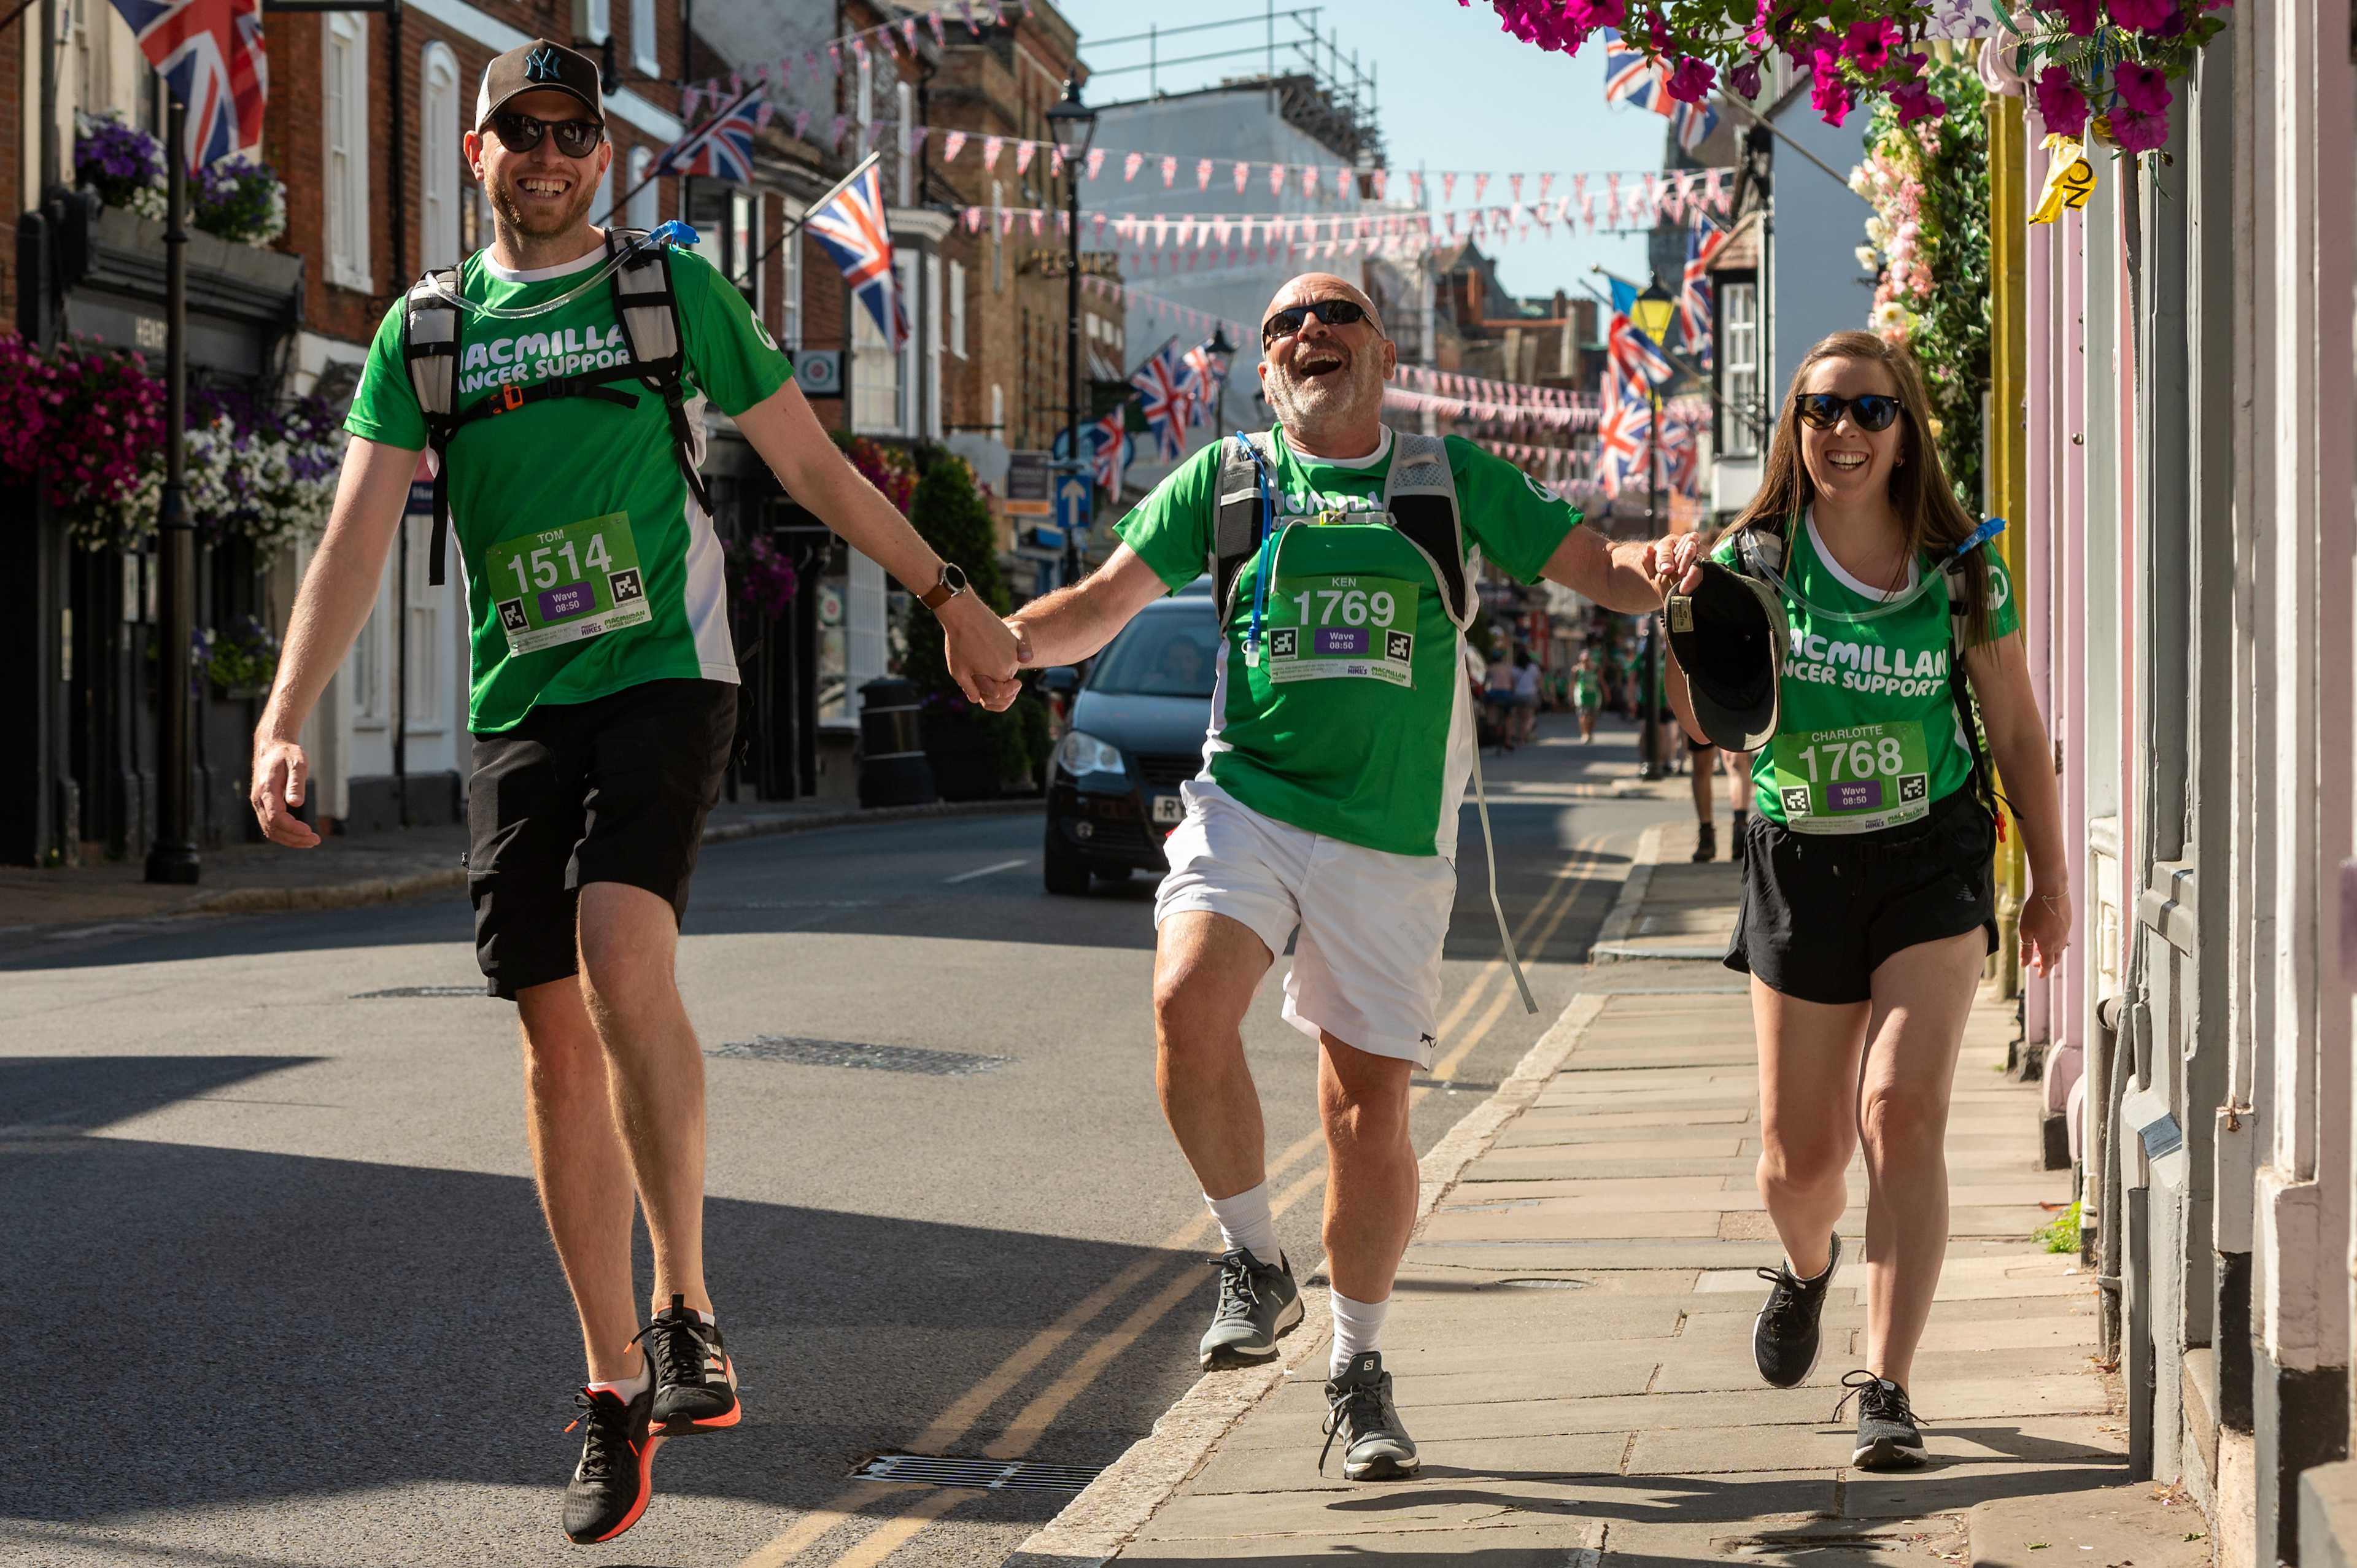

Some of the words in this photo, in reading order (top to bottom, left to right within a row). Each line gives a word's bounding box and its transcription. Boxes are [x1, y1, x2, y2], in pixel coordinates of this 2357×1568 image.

[525, 48, 561, 80] NY
[2063, 159, 2093, 209] NO
[460, 324, 627, 373] ACMILLA
[459, 363, 529, 393] NCER
[535, 349, 631, 379] SUPPOR
[537, 529, 564, 544] TOM
[508, 533, 613, 593] 1514
[1332, 577, 1357, 587] KEN
[552, 590, 578, 603] Wave
[555, 600, 580, 614] 08:50
[1293, 590, 1395, 627] 1769
[581, 625, 602, 636] HIKES
[1329, 632, 1355, 641] Wave
[1329, 641, 1354, 650] 08:50
[1790, 628, 1948, 678] ACMILLAN
[1371, 666, 1407, 679] MACMILLAN
[1781, 658, 1836, 685] NCER
[1842, 671, 1945, 698] SUPPORT
[1811, 725, 1883, 742] CHARLOTTE
[1798, 737, 1903, 783] 1768
[1841, 786, 1867, 795] Wave
[1843, 795, 1867, 806] 08:50
